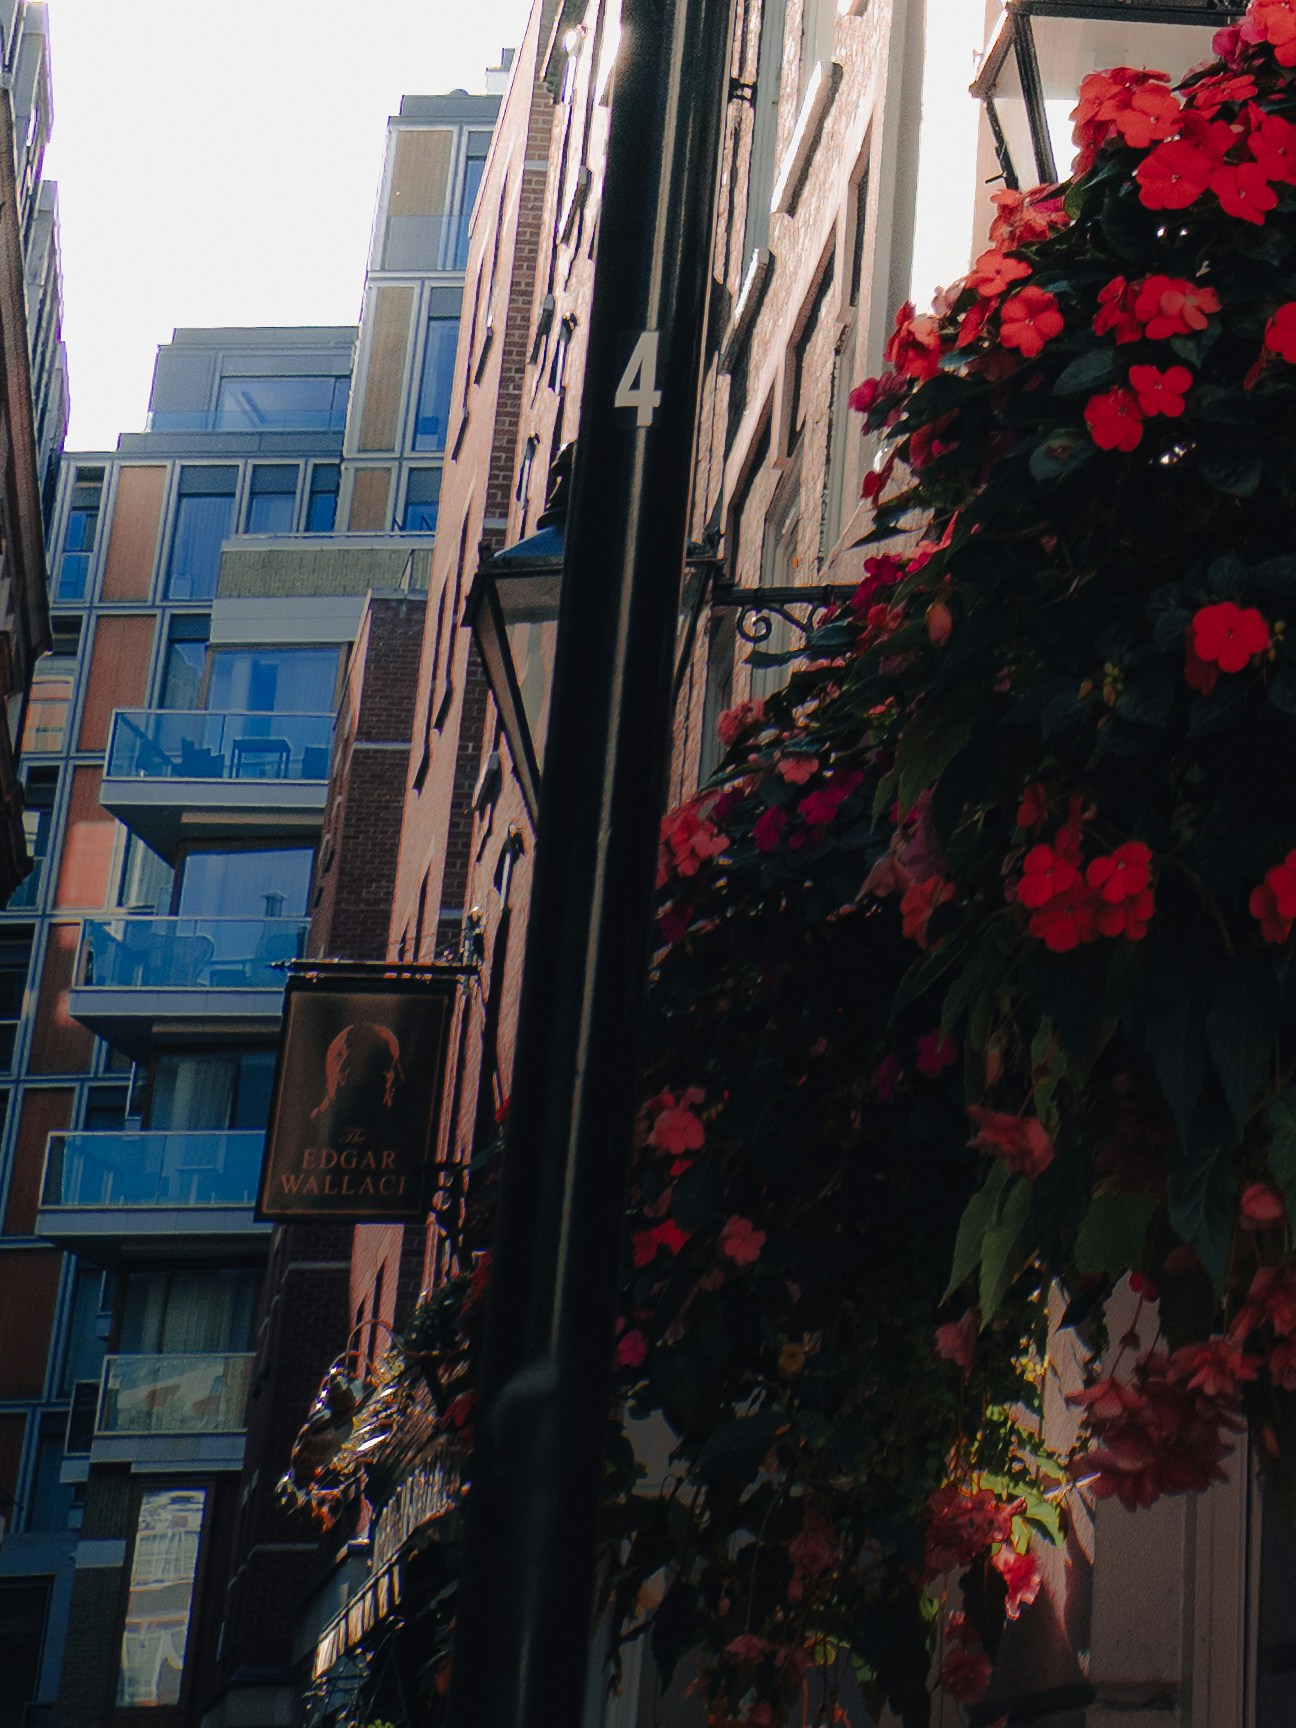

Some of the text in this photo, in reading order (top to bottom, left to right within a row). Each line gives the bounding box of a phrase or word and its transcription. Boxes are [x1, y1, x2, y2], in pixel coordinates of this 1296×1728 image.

[613, 330, 664, 428] 4
[338, 1127, 367, 1144] The
[301, 1147, 397, 1170] EDGAR
